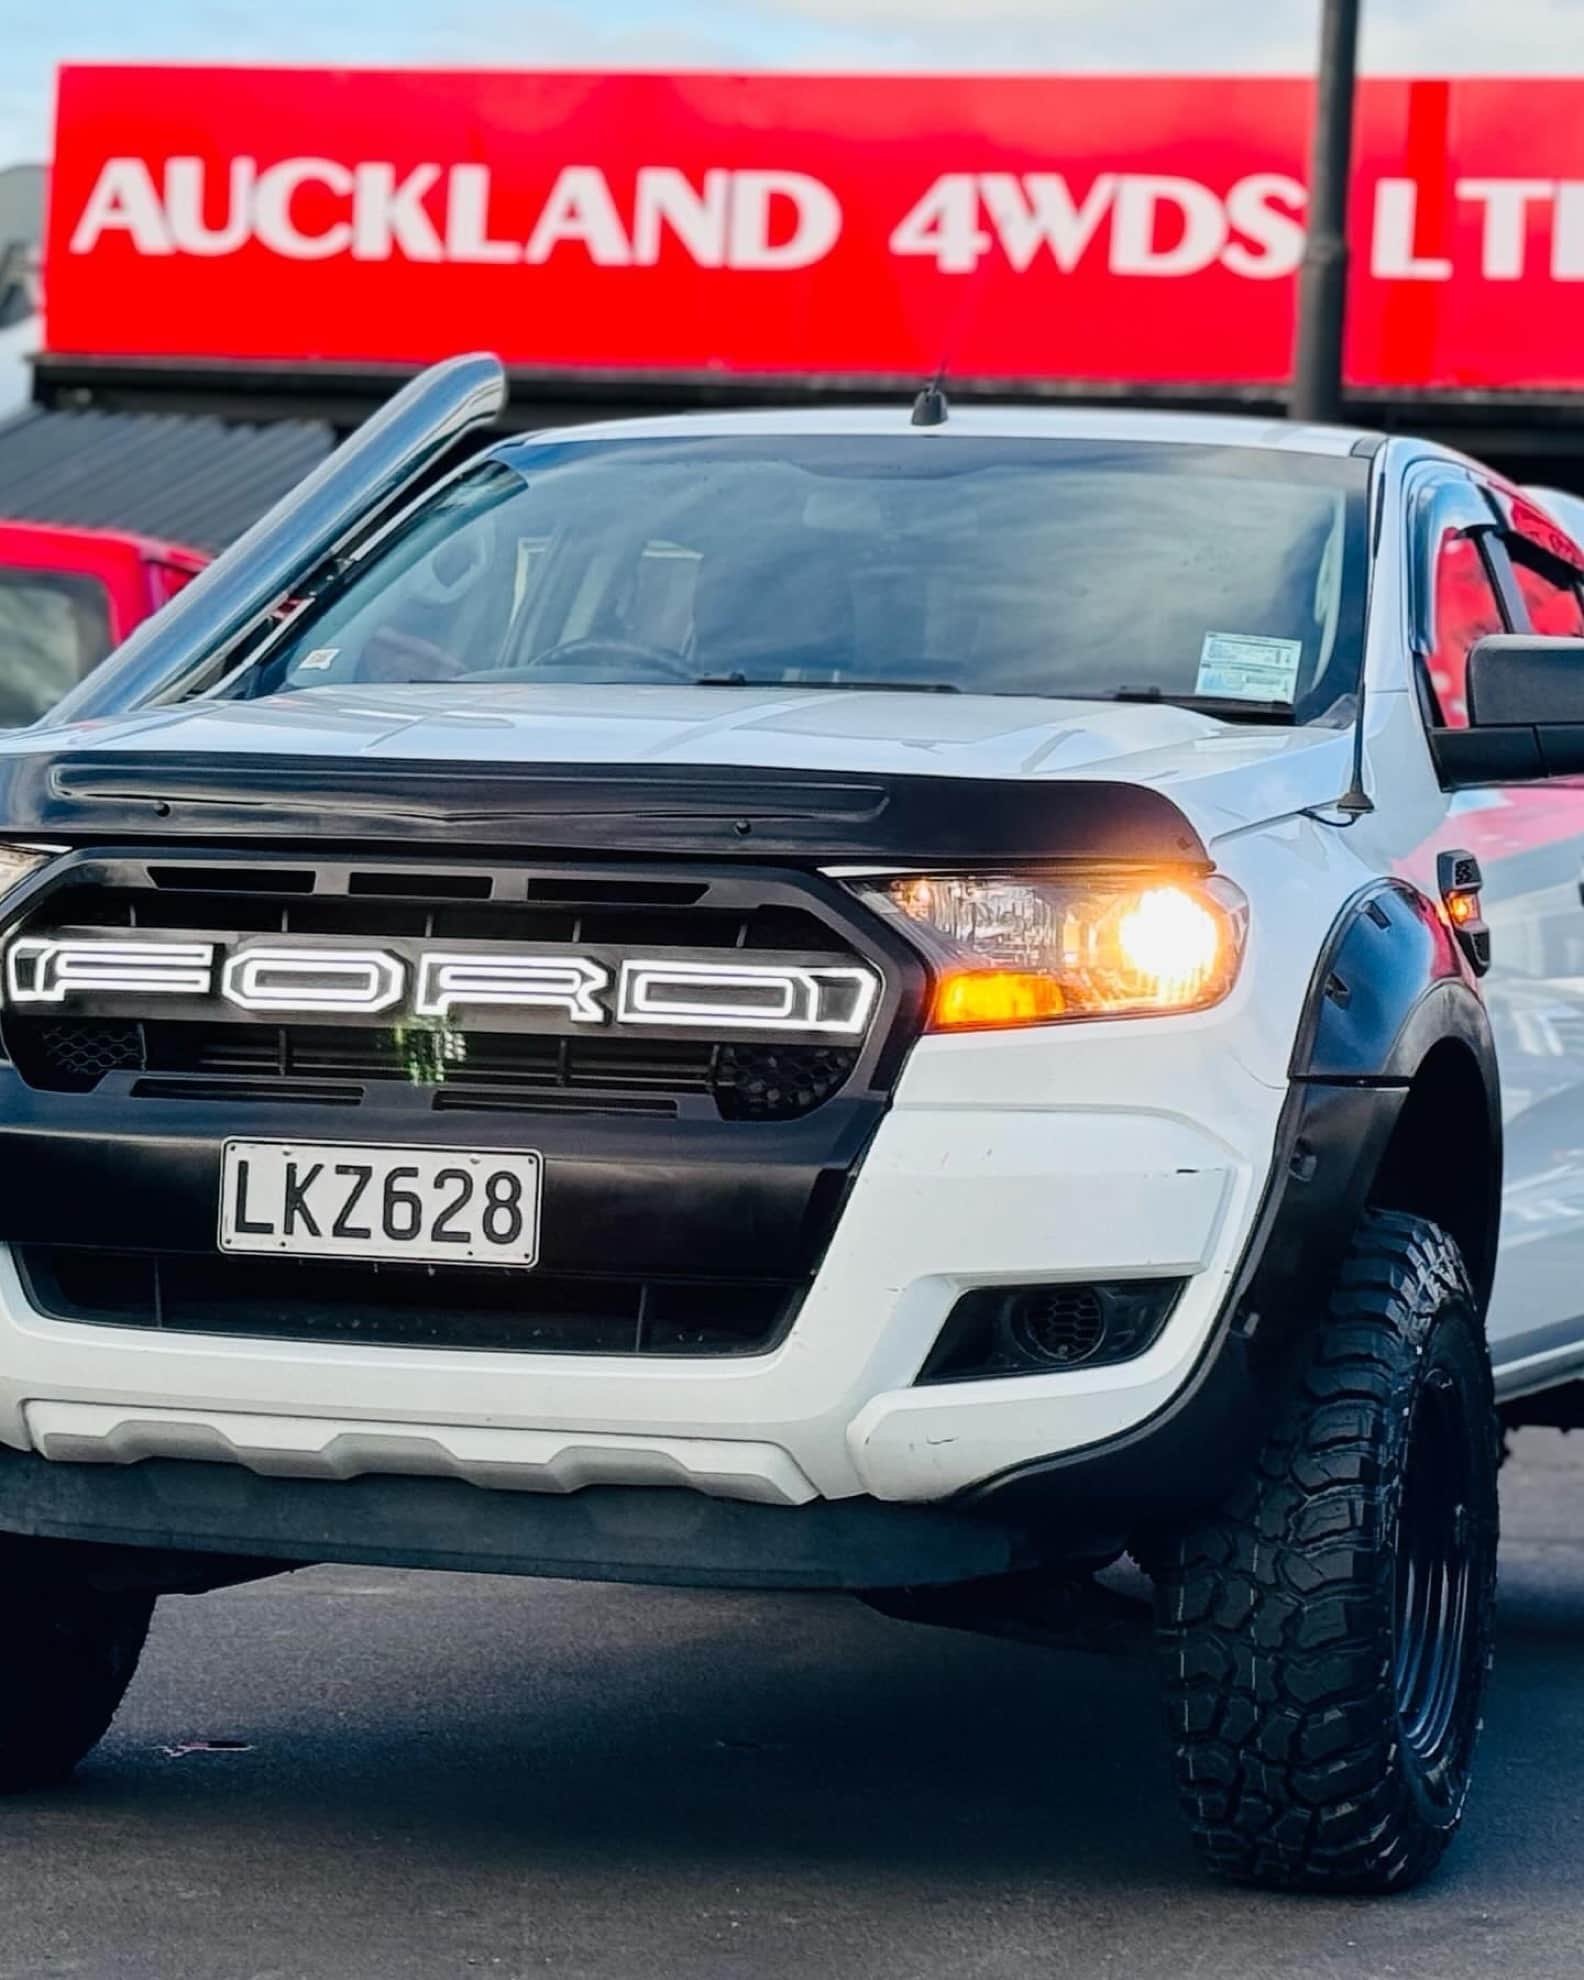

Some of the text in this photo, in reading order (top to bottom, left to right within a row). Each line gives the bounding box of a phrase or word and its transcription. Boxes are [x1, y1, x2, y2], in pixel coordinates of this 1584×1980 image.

[70, 155, 1584, 282] AUCKLAND 4WDS LT
[7, 939, 880, 1033] FORD
[232, 1159, 524, 1245] LKZ628
